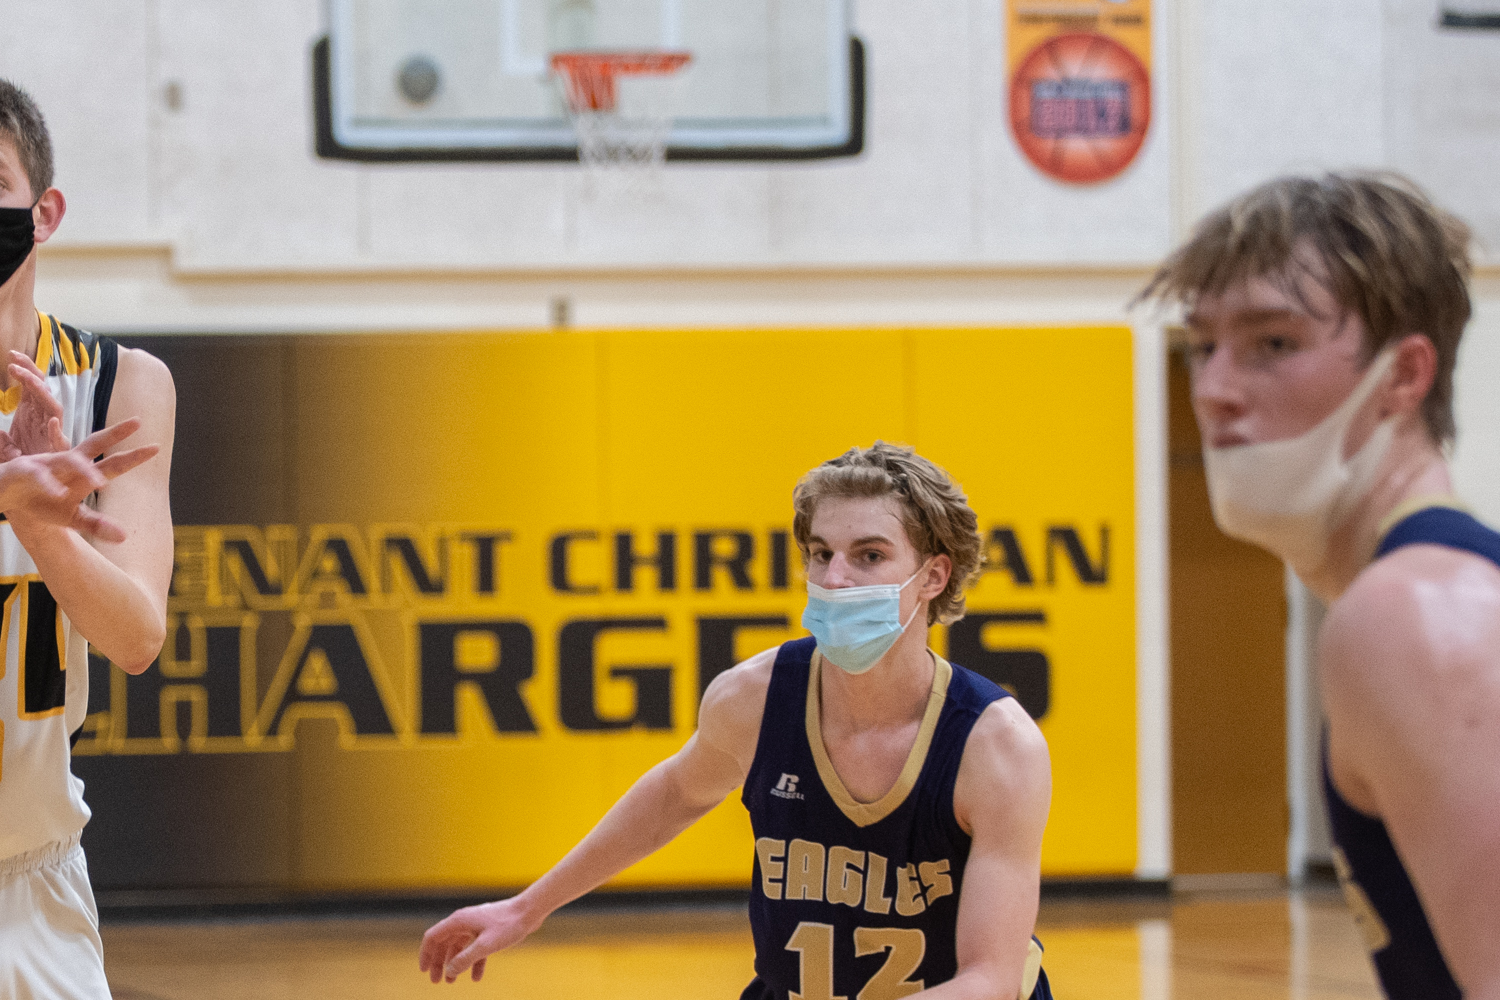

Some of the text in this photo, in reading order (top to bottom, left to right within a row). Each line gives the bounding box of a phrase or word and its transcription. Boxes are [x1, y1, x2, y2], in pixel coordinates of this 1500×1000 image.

[168, 524, 1111, 610] ENANT CHRIAN
[755, 837, 954, 917] EAGLES
